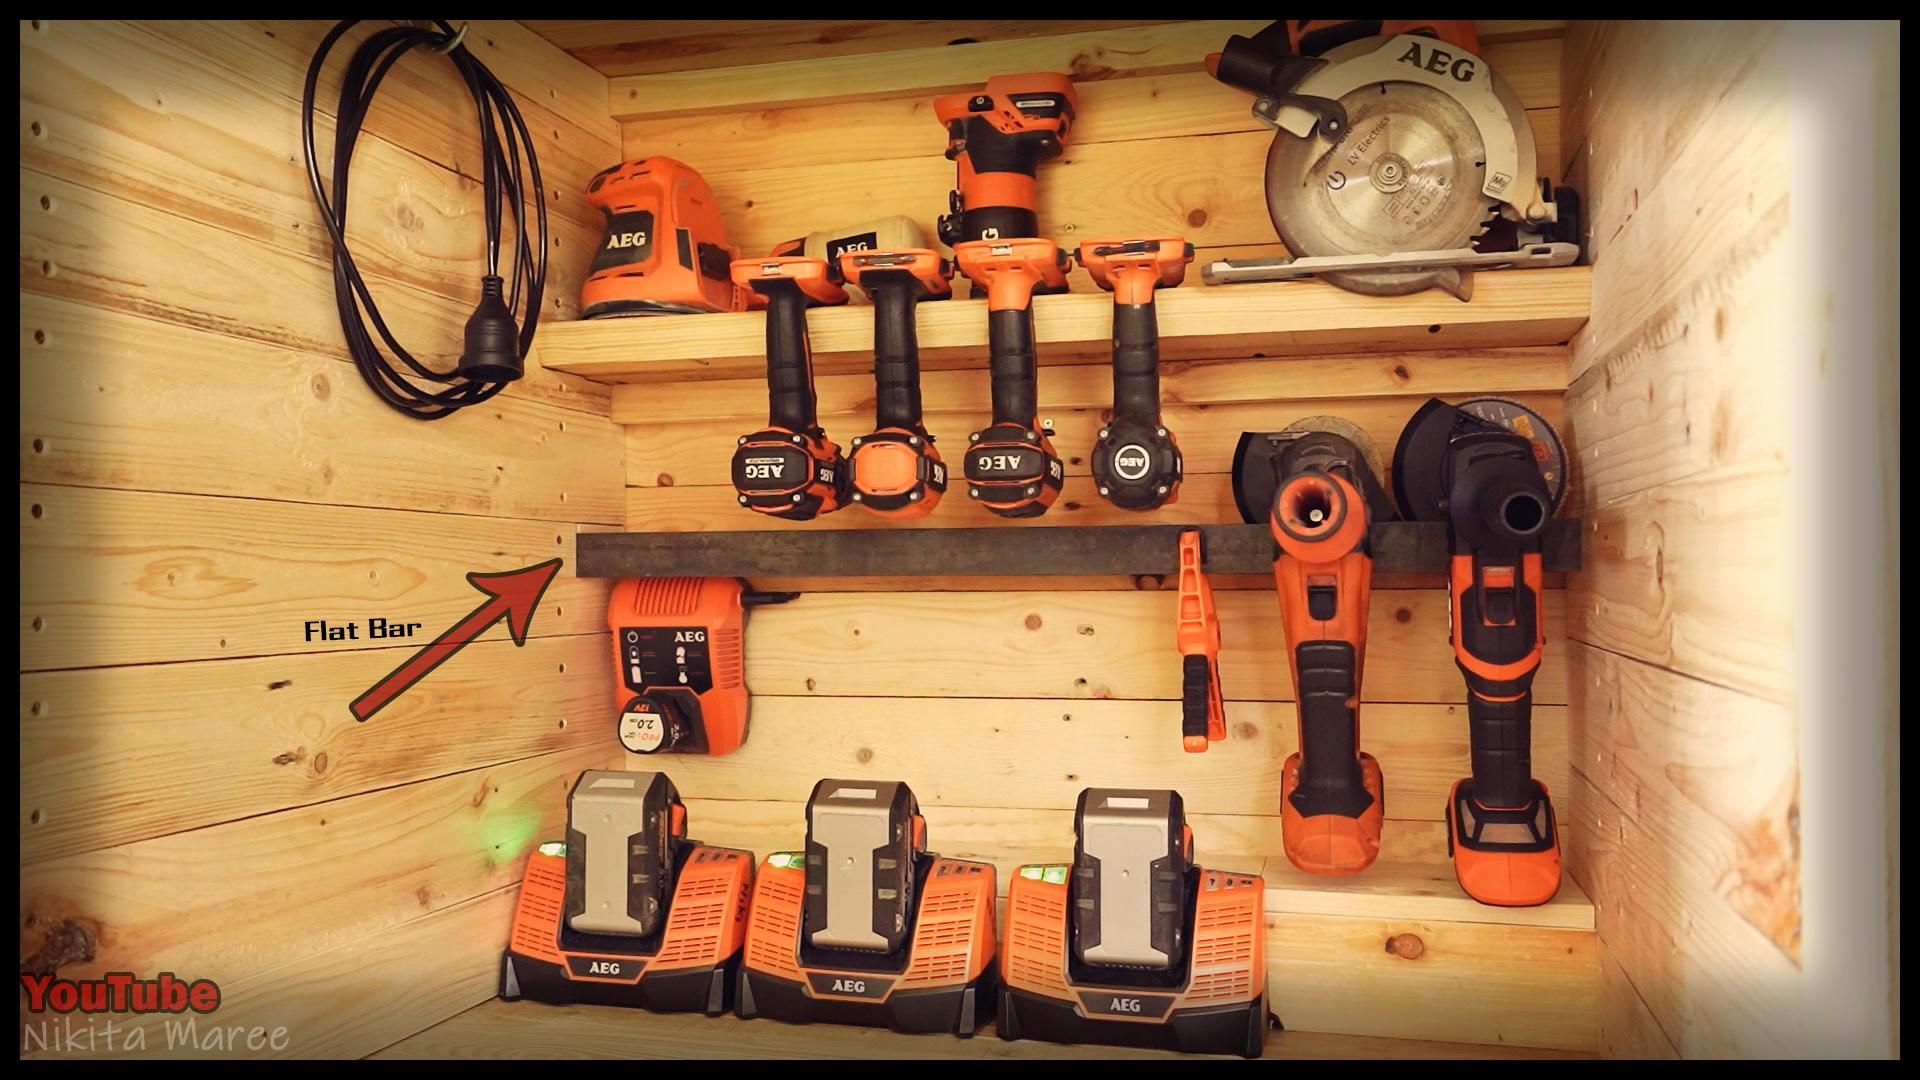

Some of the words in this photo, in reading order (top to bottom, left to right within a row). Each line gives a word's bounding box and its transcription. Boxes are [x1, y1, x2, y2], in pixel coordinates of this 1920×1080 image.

[1397, 42, 1476, 83] AEG
[1359, 115, 1391, 153] Electrics
[606, 231, 647, 250] AEG
[835, 241, 869, 259] AEG
[978, 455, 1022, 471] AEG
[1119, 457, 1145, 468] AEG
[745, 464, 785, 479] AEG
[820, 468, 834, 483] AEG
[674, 631, 705, 643] AEG
[637, 719, 654, 730] 2.0
[589, 961, 620, 975] AEG
[832, 978, 866, 993] AEG
[1110, 997, 1141, 1013] AEG
